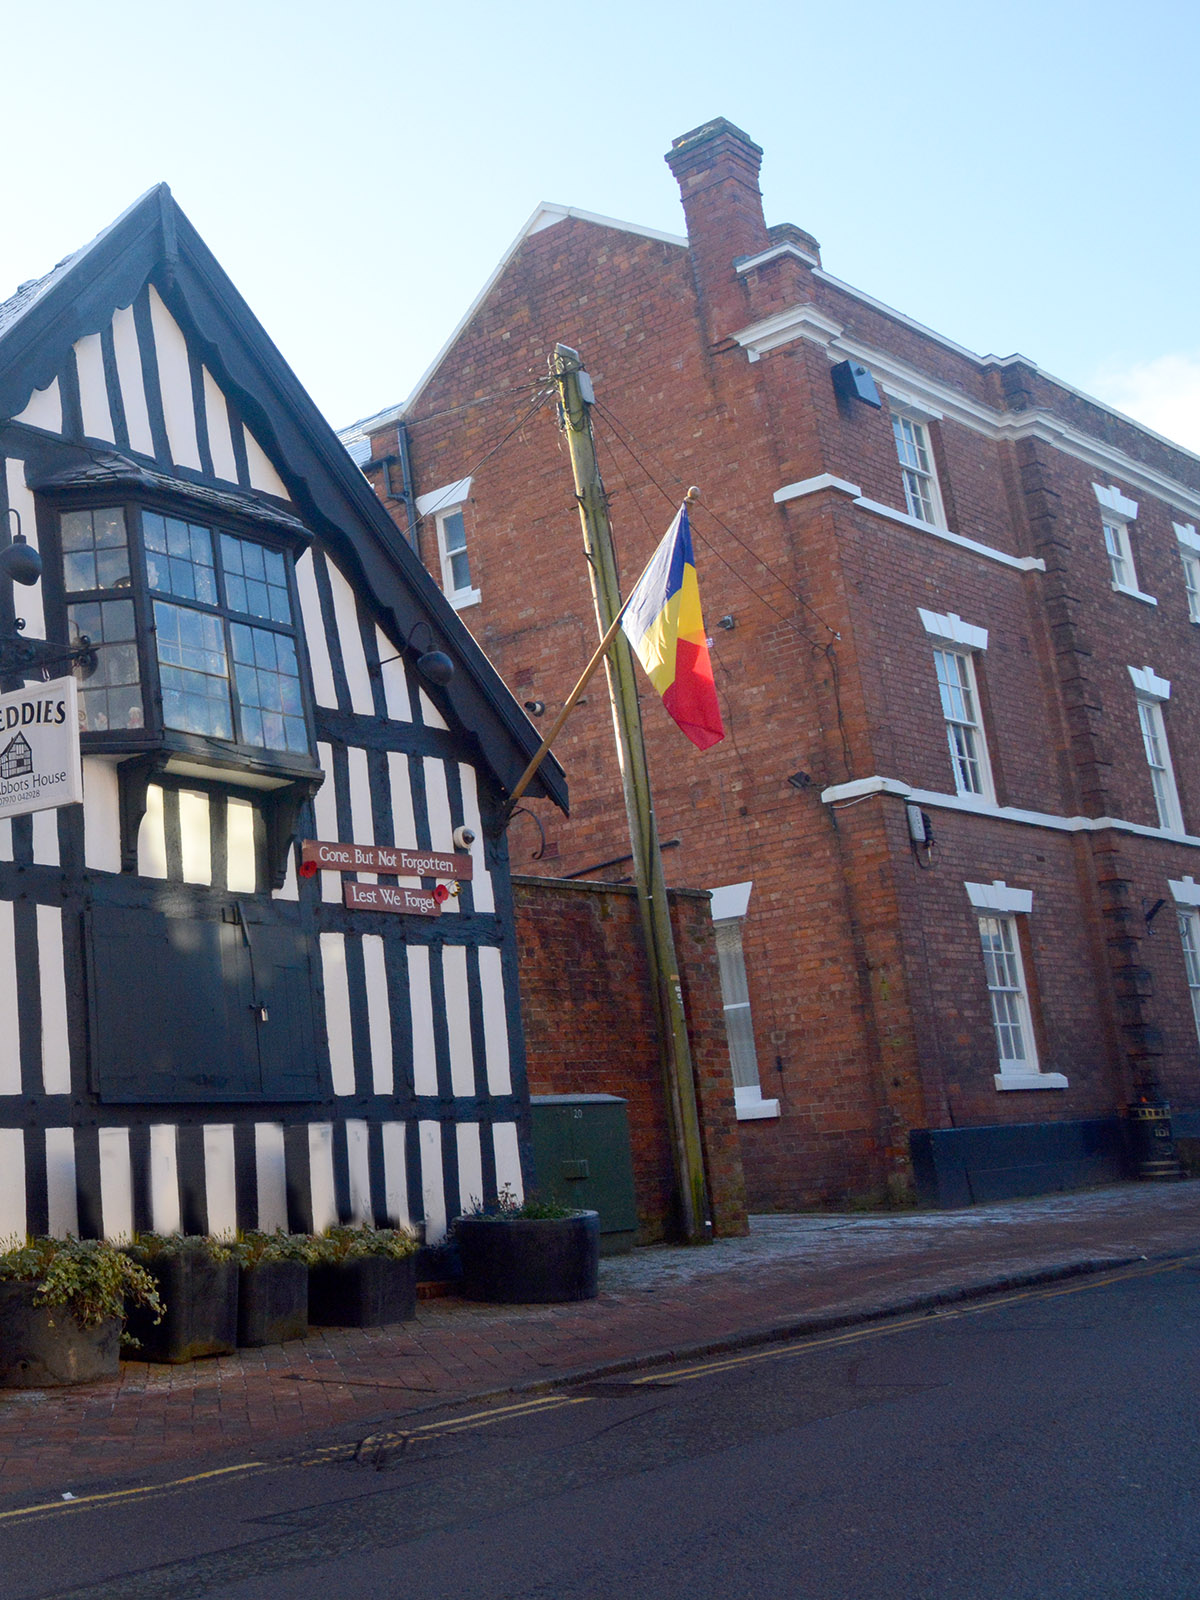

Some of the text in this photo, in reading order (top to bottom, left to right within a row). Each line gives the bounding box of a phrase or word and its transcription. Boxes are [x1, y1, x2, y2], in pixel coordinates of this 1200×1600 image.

[32, 771, 67, 788] House
[355, 849, 374, 865] But
[378, 851, 397, 867] Not
[401, 853, 458, 875] Forgotten.
[352, 886, 436, 913] Lest We Forget
